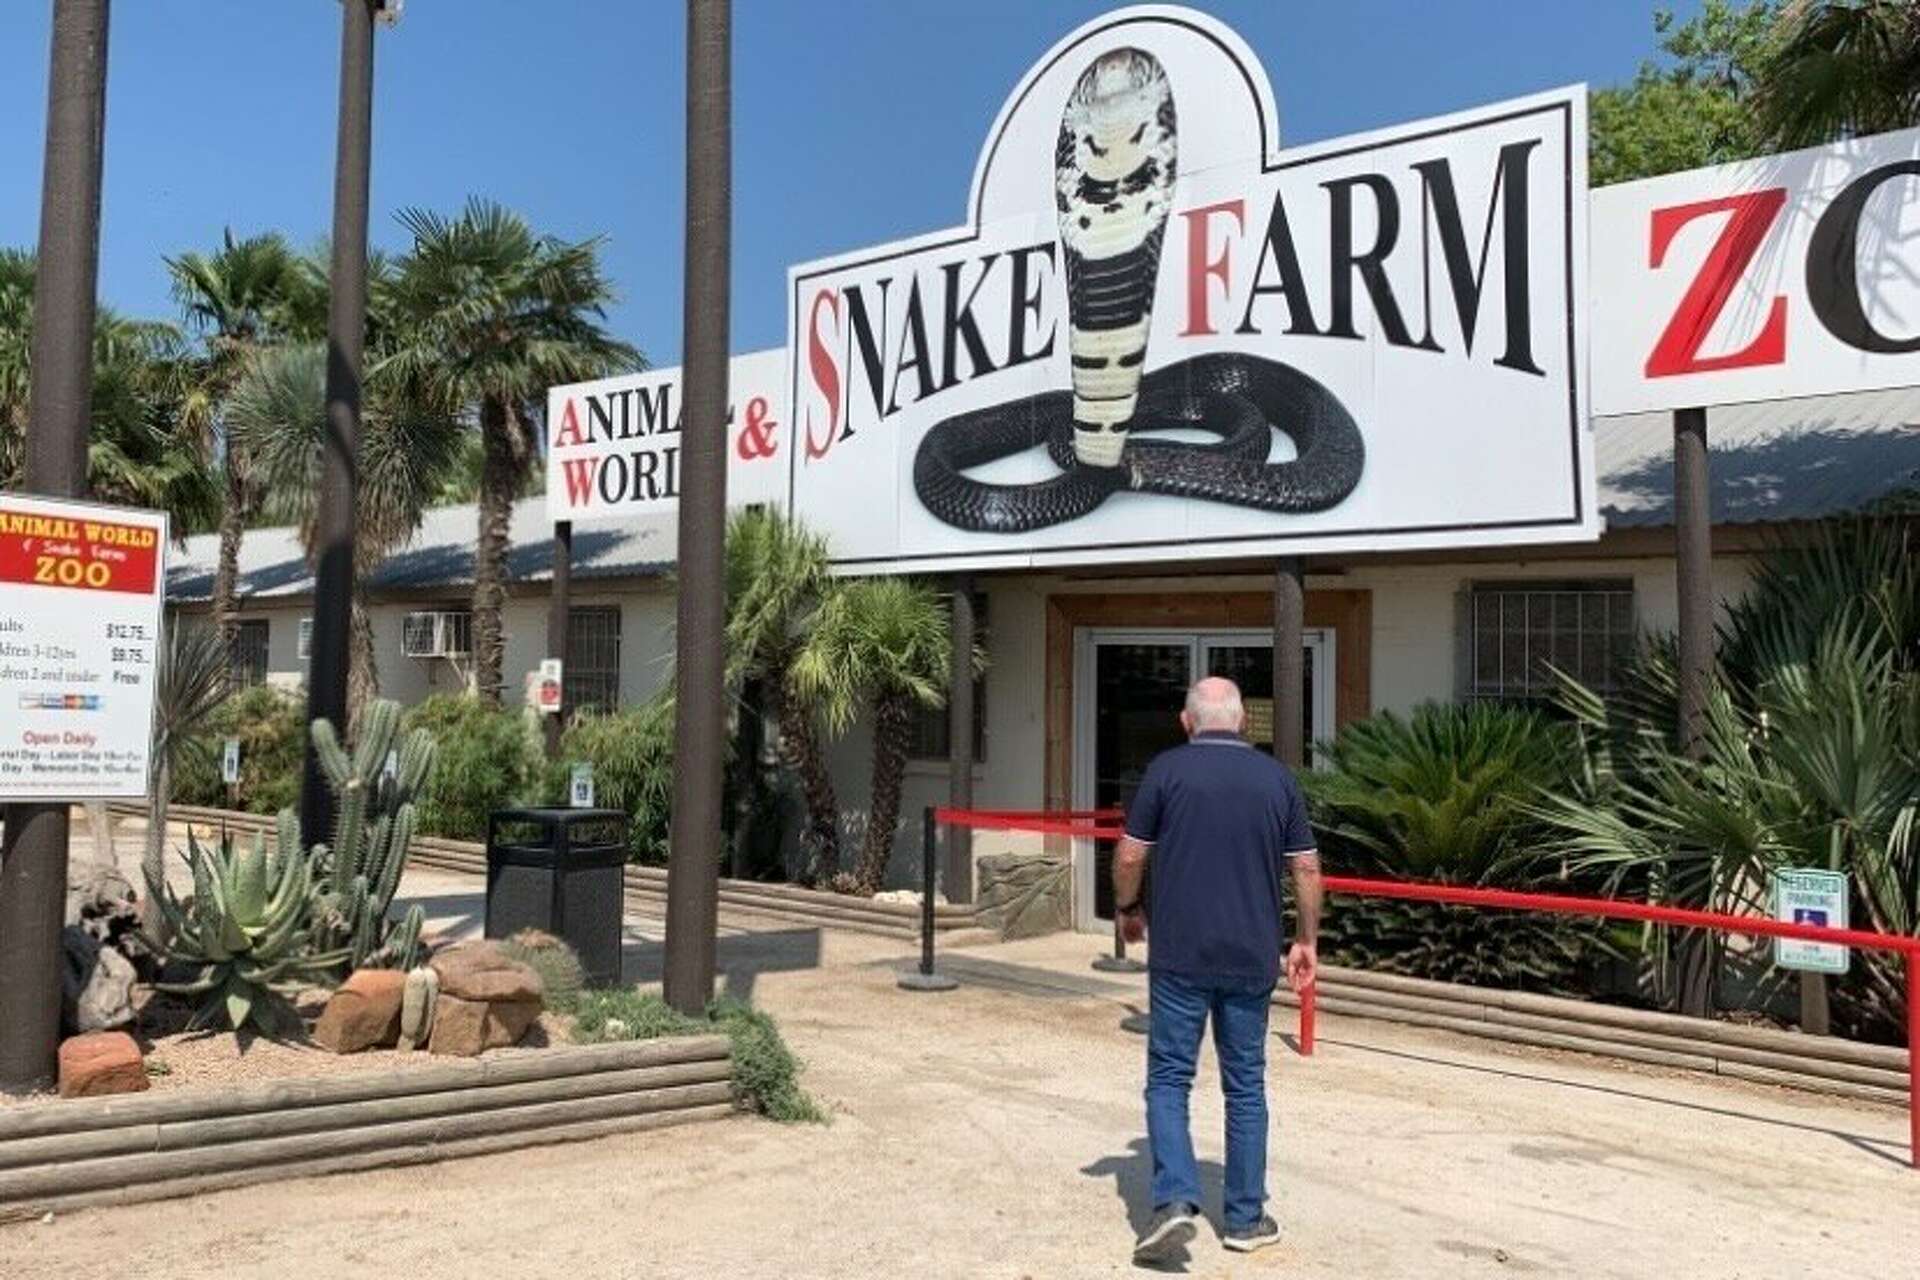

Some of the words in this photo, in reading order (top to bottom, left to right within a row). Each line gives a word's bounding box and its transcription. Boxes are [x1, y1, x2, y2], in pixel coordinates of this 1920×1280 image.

[804, 241, 1057, 465] SNAKE
[1177, 138, 1546, 377] FARM
[737, 396, 778, 460] &
[562, 446, 681, 507] WORL
[85, 521, 154, 548] WORLD
[34, 555, 111, 587] ZOO
[113, 670, 140, 685] Free
[23, 731, 60, 746] Open
[63, 731, 97, 747] Daily
